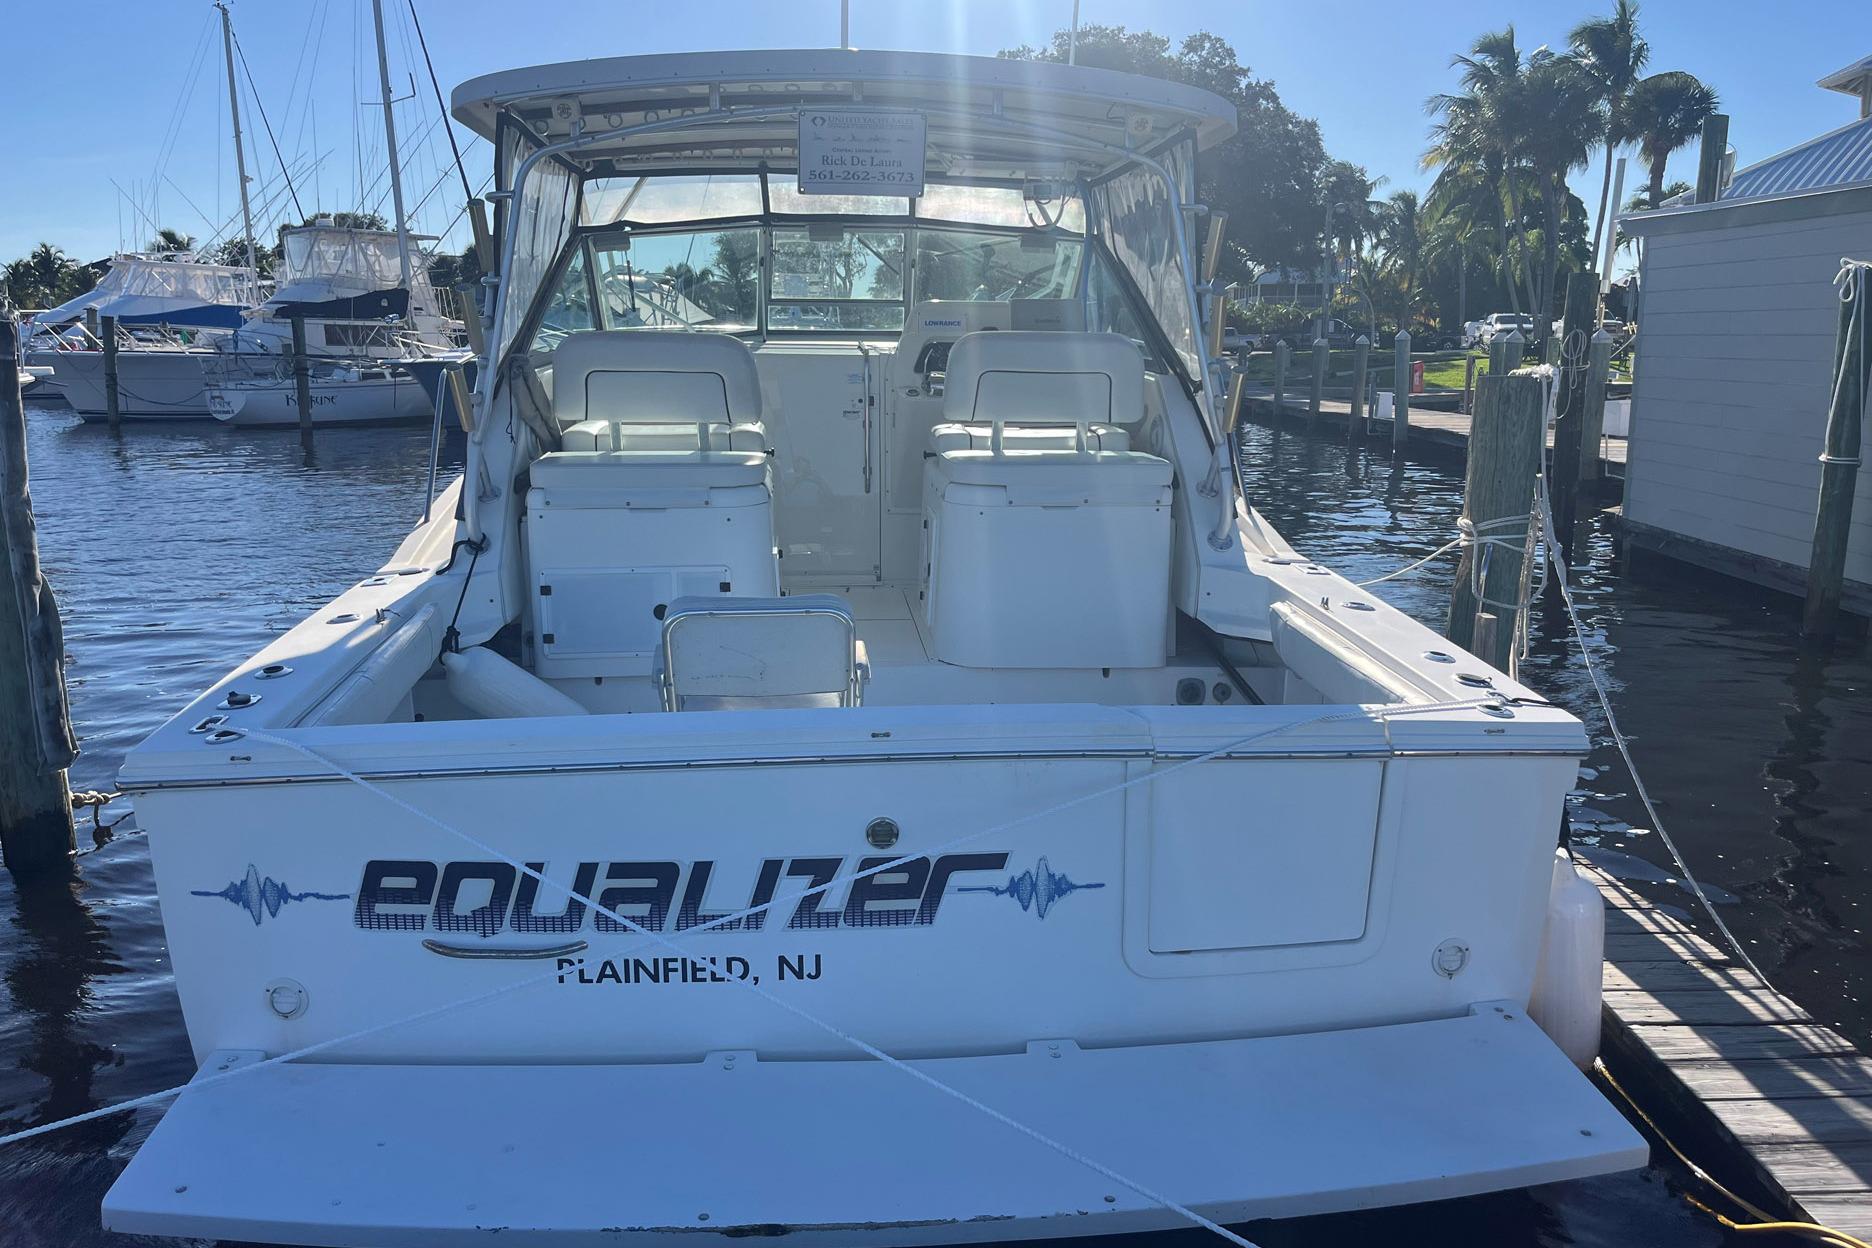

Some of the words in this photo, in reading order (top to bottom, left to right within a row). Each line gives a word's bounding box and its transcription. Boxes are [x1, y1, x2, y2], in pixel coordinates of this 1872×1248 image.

[821, 154, 847, 167] Rick
[851, 155, 866, 167] De
[870, 156, 902, 168] Laura
[808, 169, 914, 183] 561-262-3673
[557, 956, 760, 986] PLAINFIELD,
[777, 954, 822, 981] NJ
